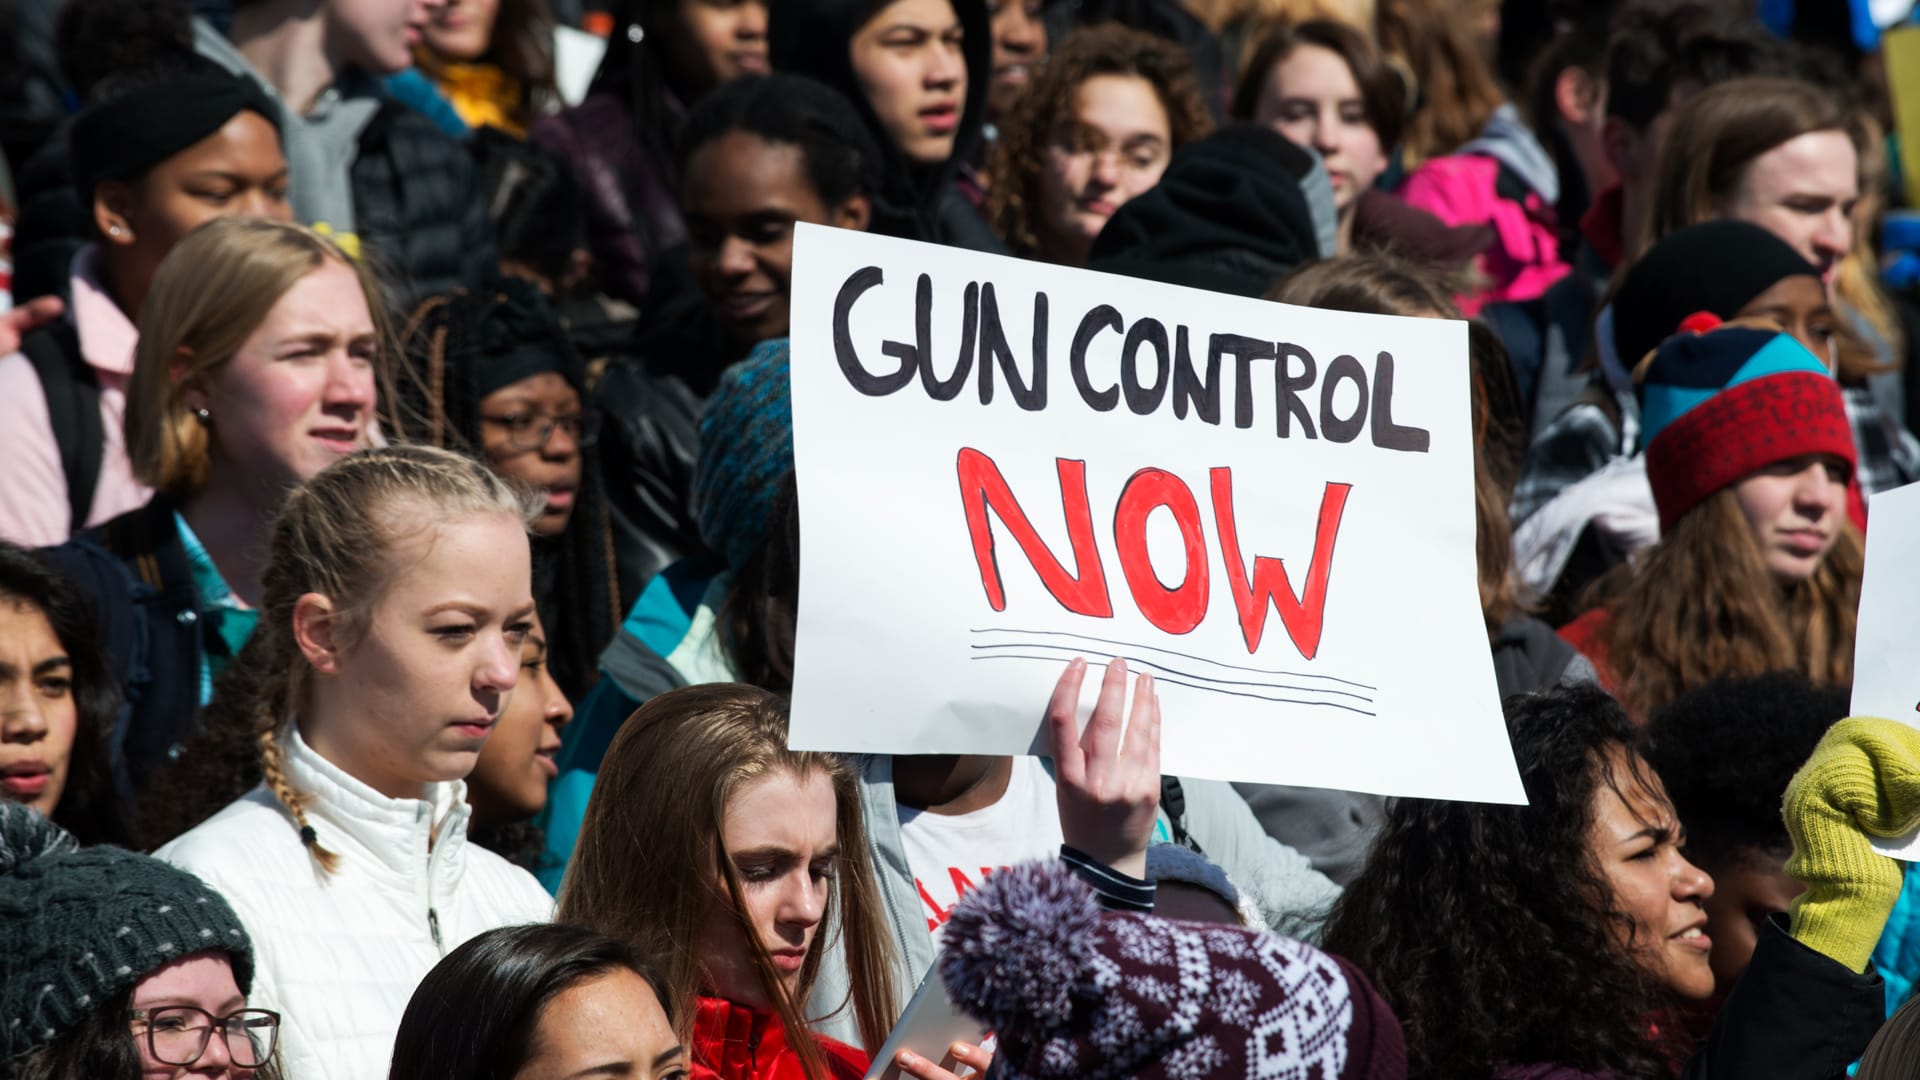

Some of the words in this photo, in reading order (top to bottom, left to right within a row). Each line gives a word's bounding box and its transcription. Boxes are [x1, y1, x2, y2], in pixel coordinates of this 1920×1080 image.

[833, 266, 1049, 412] GUN
[1070, 304, 1431, 453] CONTROL
[957, 447, 1353, 661] NOW
